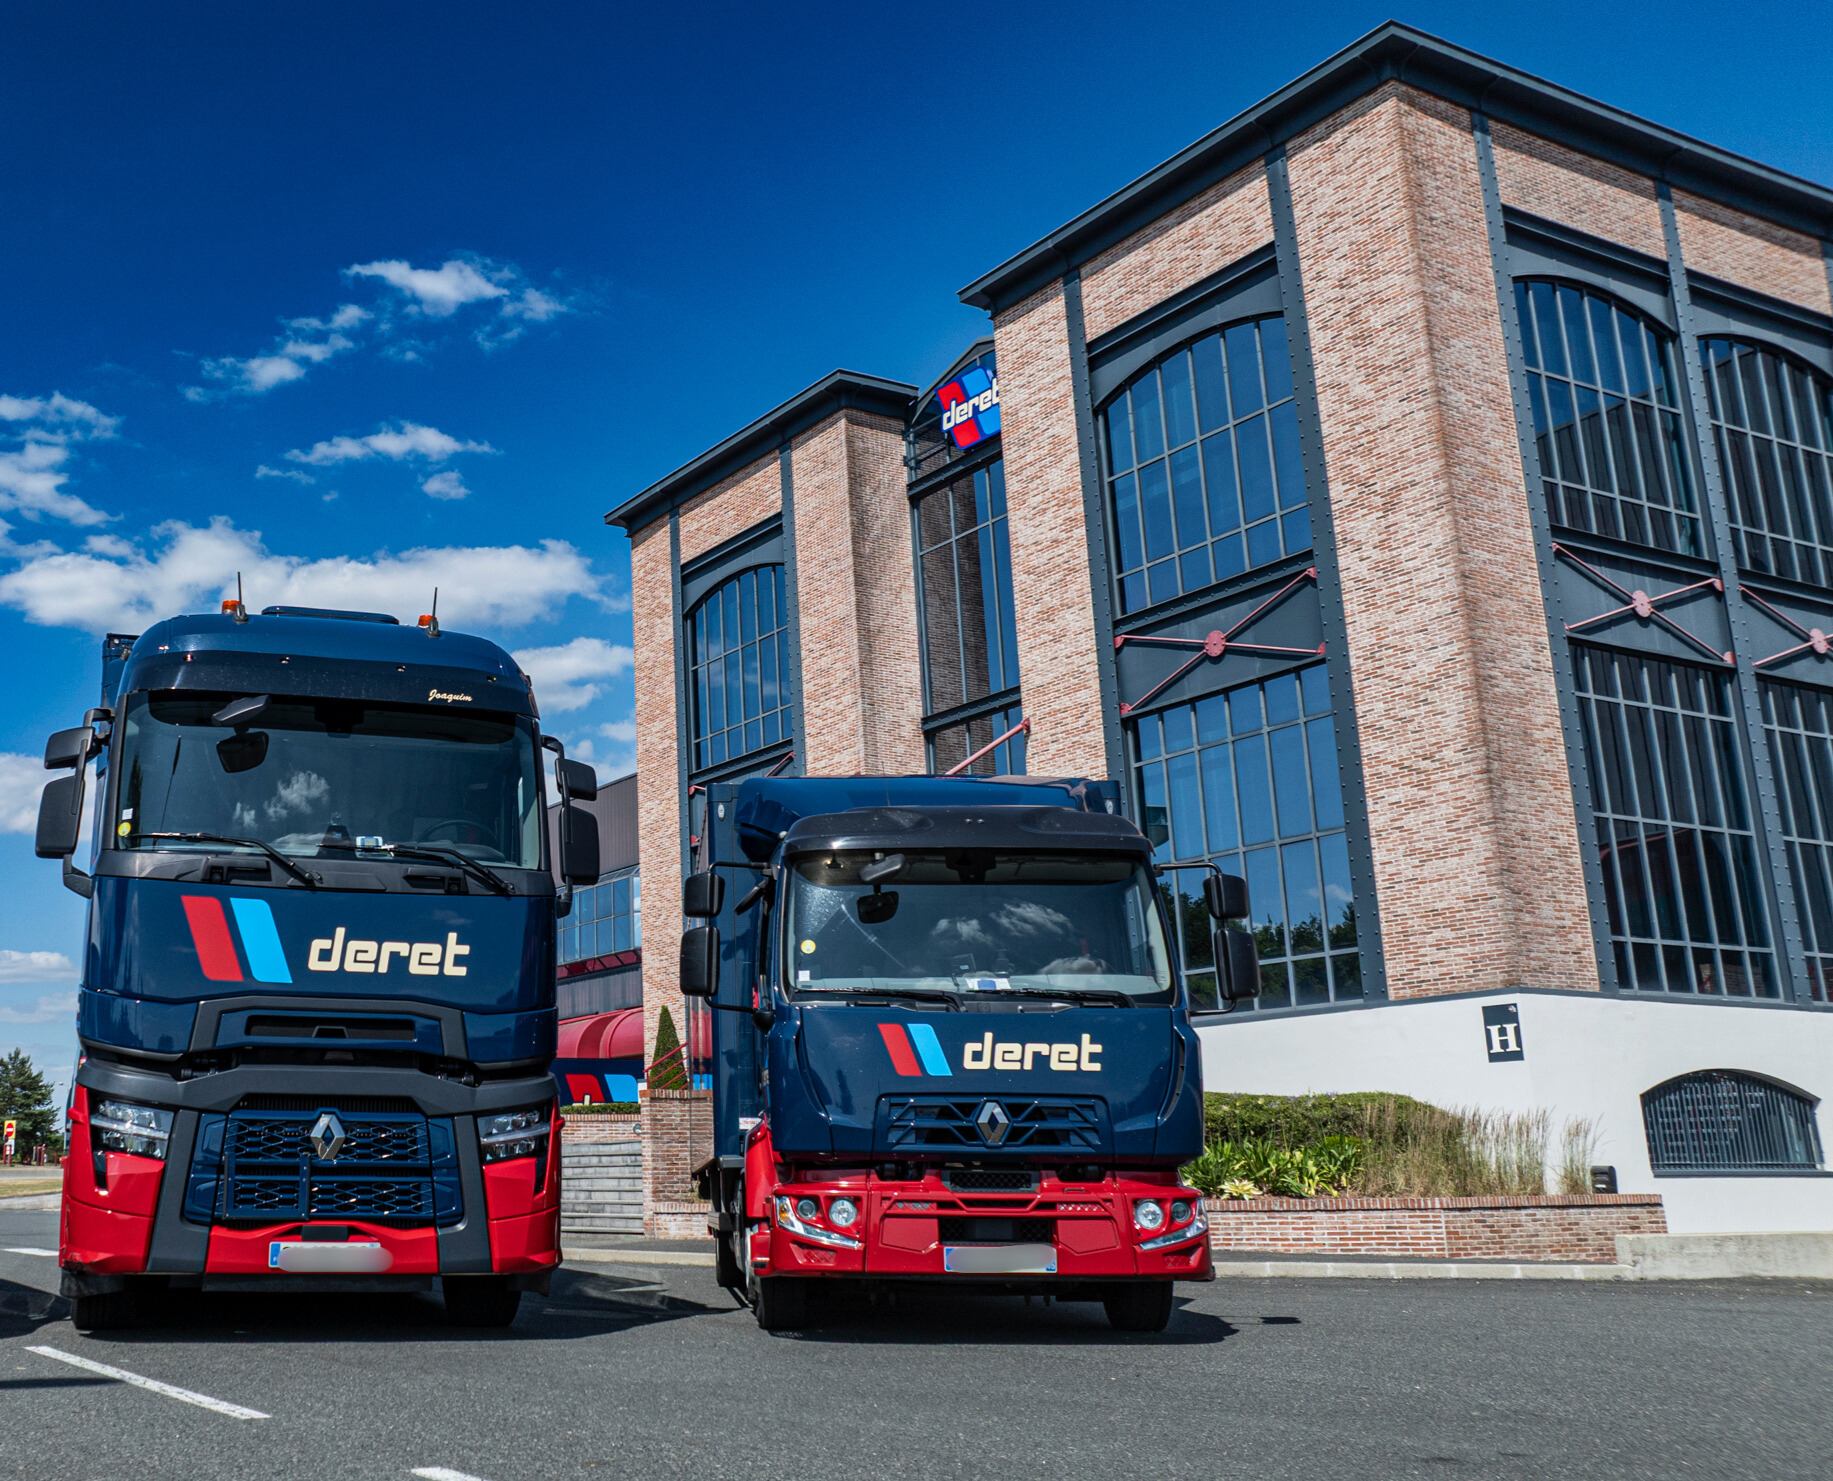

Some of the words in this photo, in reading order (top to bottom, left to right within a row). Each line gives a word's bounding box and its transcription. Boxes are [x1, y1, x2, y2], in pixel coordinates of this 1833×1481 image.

[428, 689, 473, 703] Joaquim
[307, 926, 471, 977] deret
[963, 1031, 1103, 1072] deret
[1486, 1023, 1521, 1053] H
